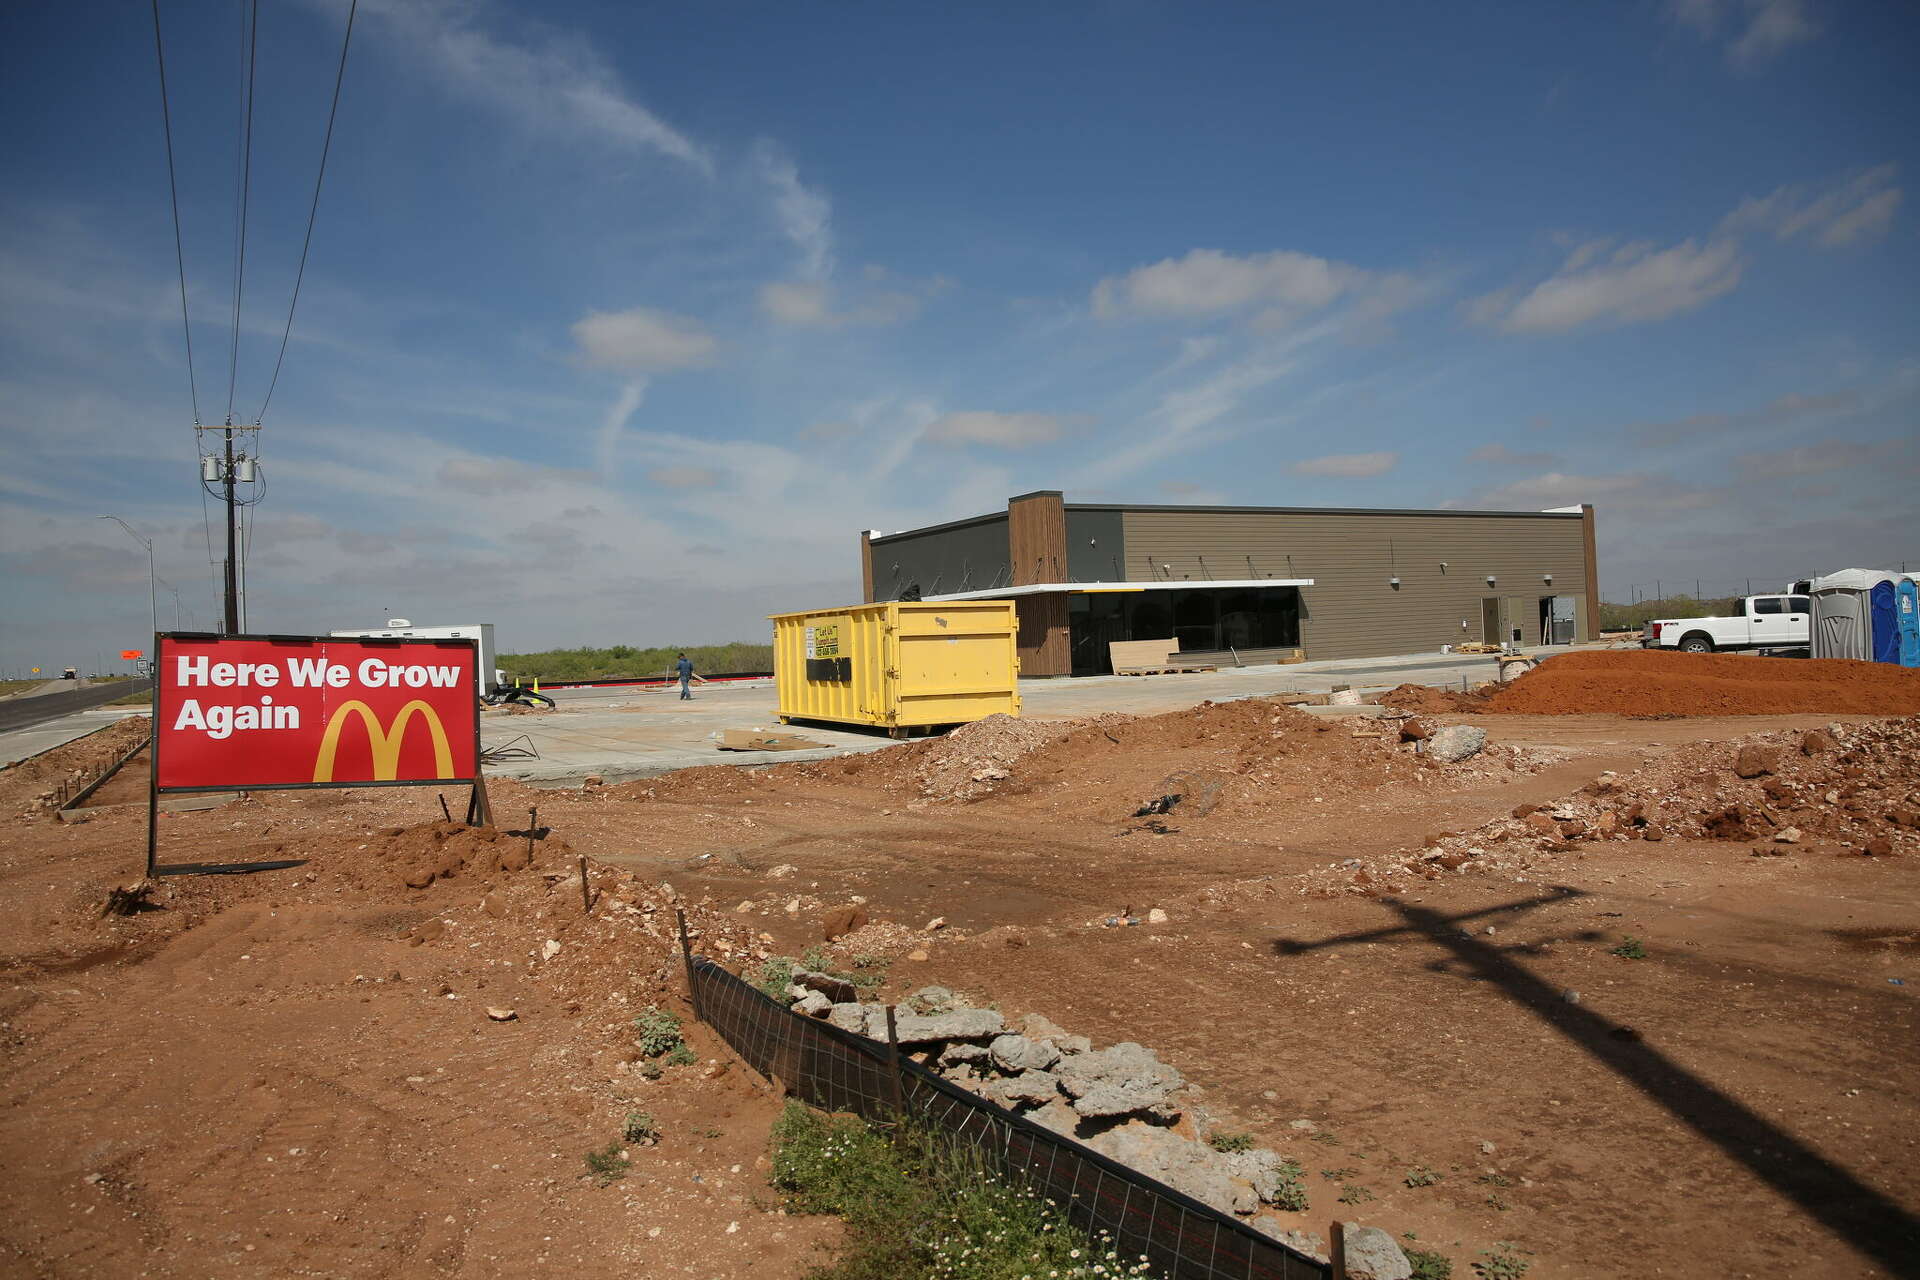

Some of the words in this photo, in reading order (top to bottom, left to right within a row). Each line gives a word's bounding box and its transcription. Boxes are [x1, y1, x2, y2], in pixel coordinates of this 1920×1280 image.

[177, 655, 280, 688] Here
[286, 657, 351, 688] We
[357, 657, 461, 688] Grow
[173, 695, 300, 740] Again
